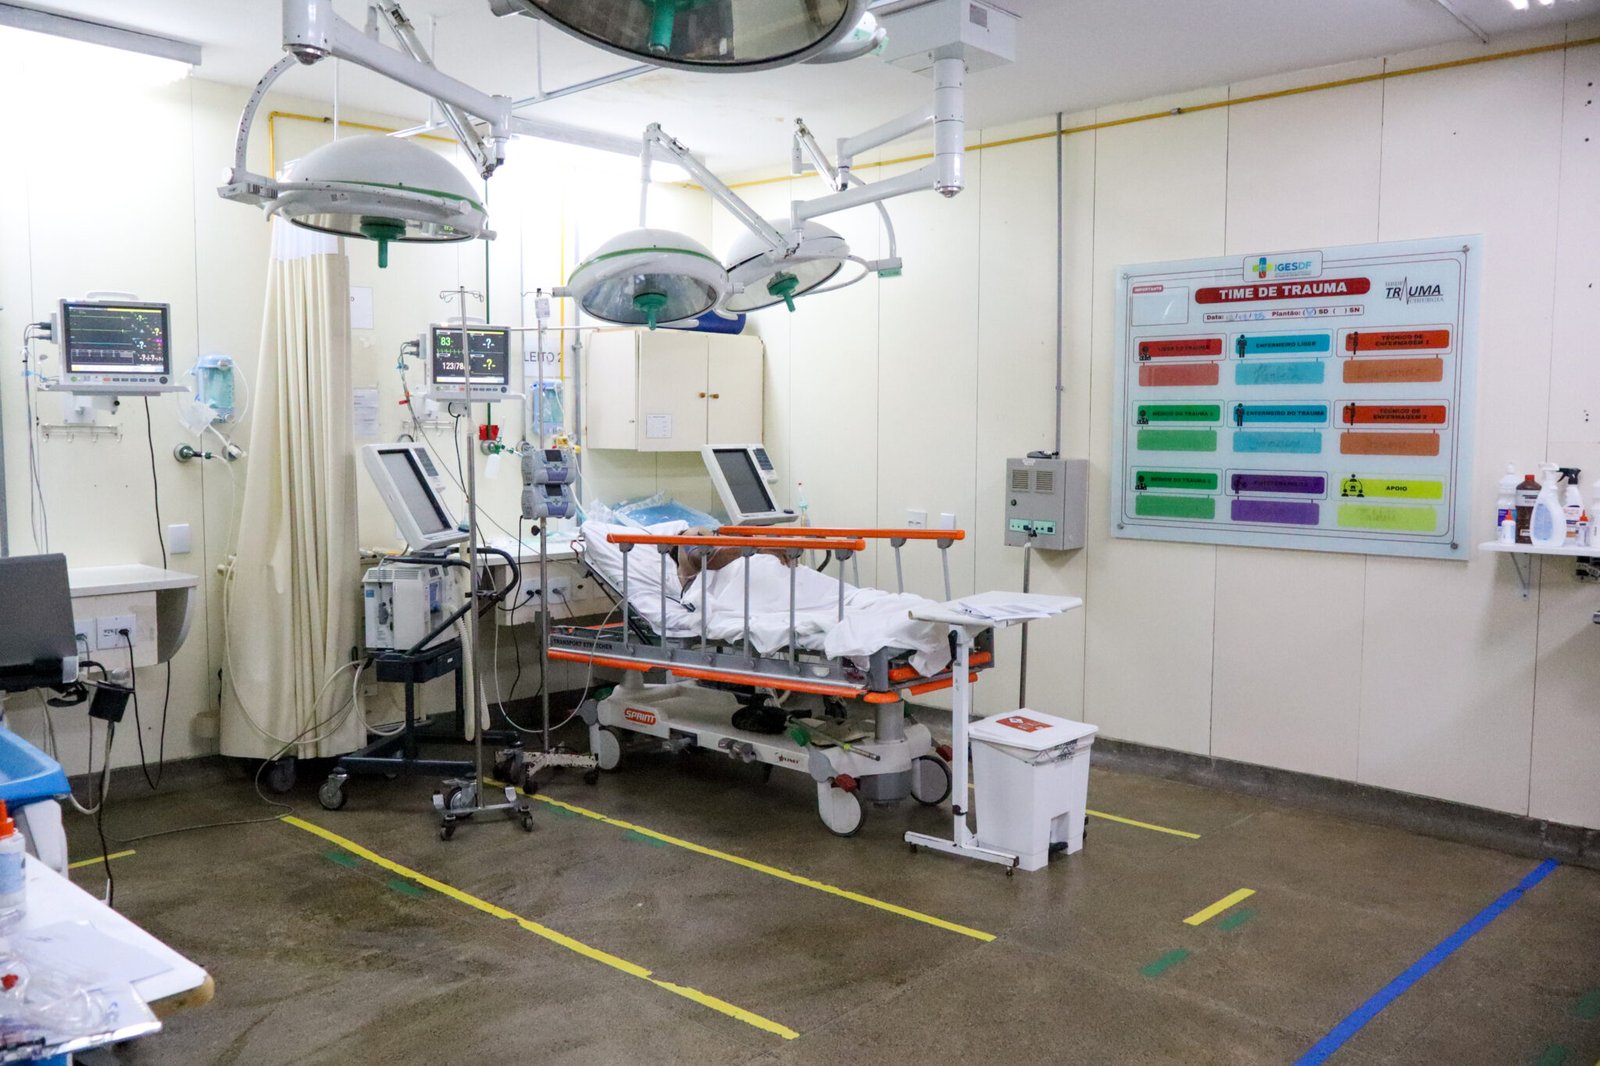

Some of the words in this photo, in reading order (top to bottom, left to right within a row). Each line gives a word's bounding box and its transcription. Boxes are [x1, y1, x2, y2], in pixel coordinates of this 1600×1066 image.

[1274, 261, 1312, 271] IGESDF
[1219, 288, 1254, 299] TIME
[1258, 287, 1277, 297] DE
[1281, 282, 1347, 296] TRAUMA
[440, 337, 451, 346] 83
[523, 351, 555, 363] LEITO
[626, 710, 656, 723] SPRINT
